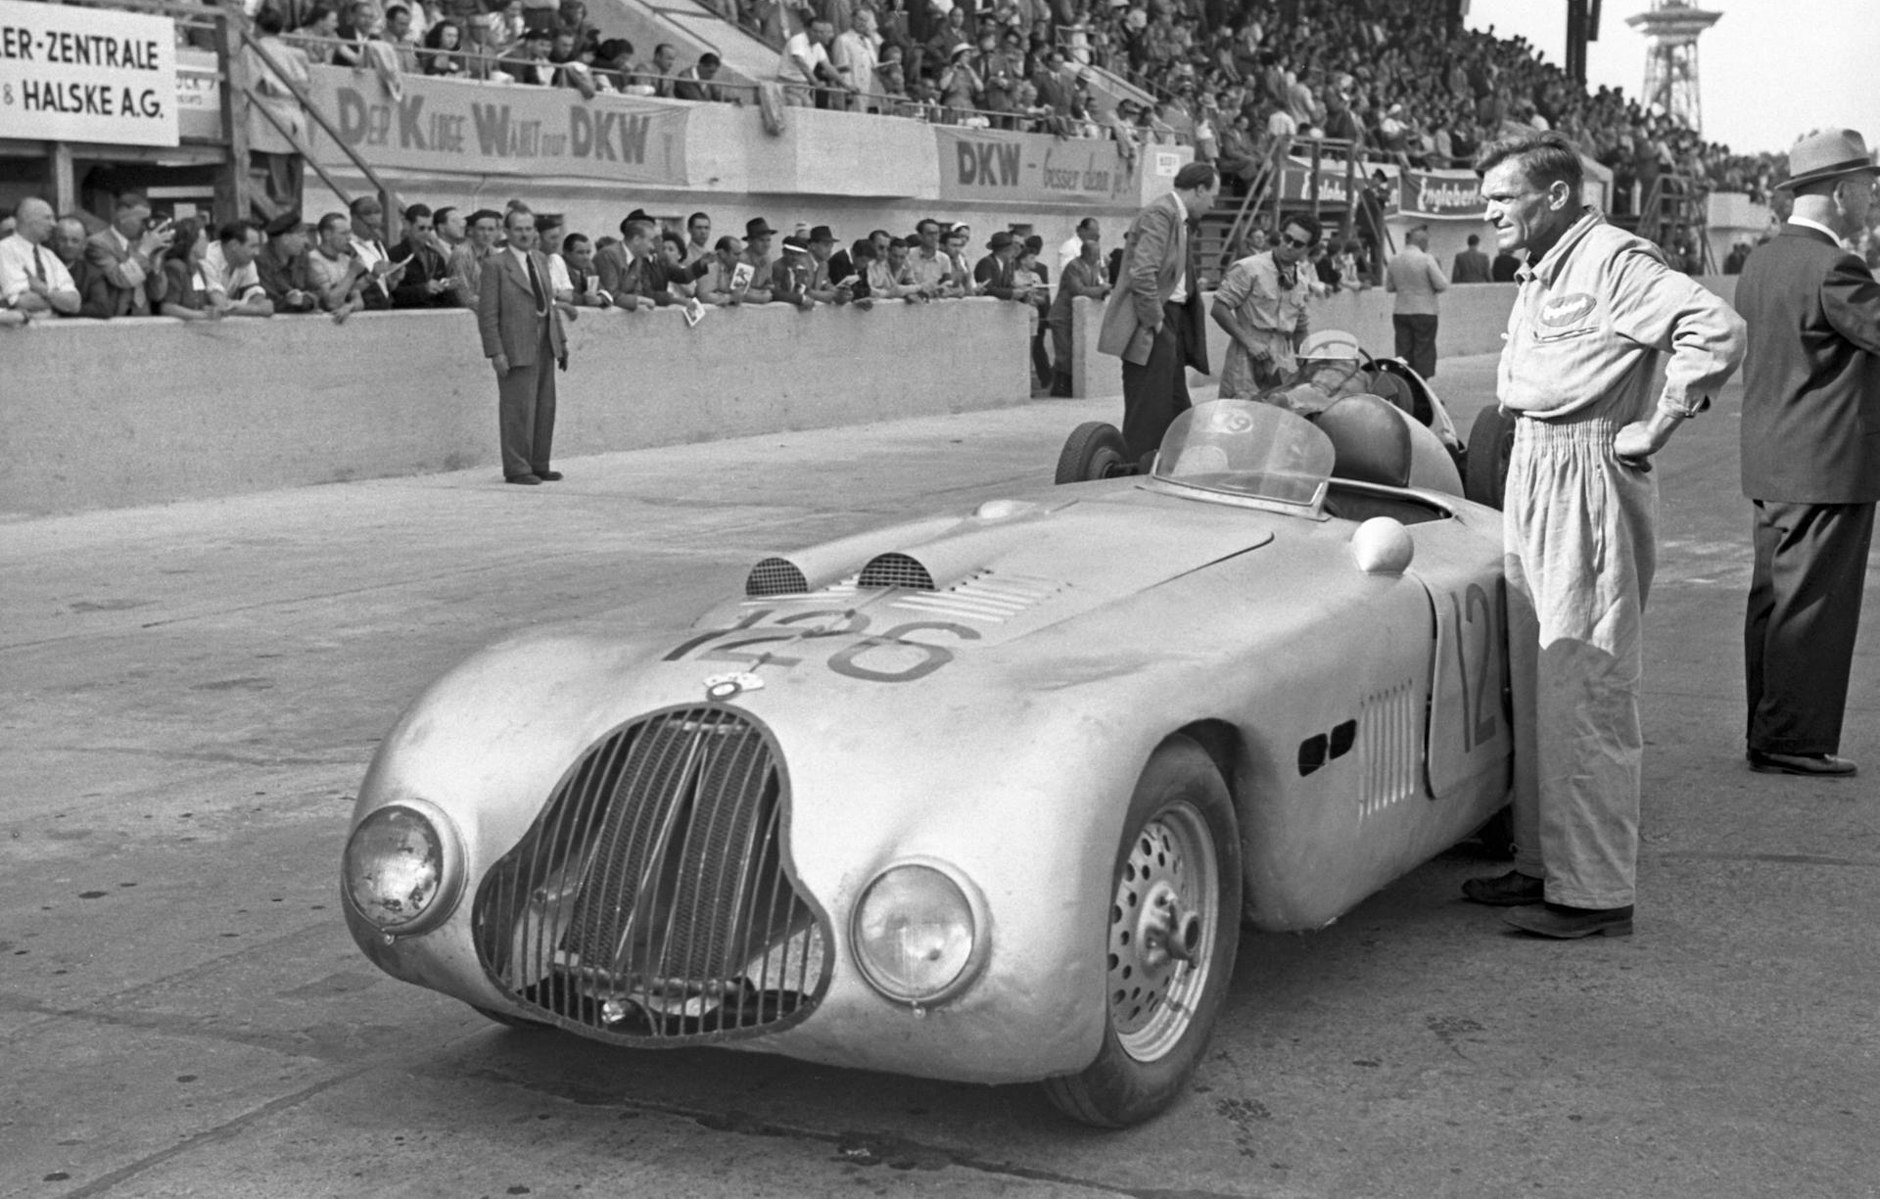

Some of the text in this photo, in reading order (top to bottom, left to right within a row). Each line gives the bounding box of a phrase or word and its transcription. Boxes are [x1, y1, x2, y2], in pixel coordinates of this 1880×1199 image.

[0, 26, 159, 70] ER-ZENTRALE
[2, 79, 164, 119] & HALSKE A.G.
[569, 104, 650, 165] DKW
[956, 140, 1022, 187] DKW
[661, 608, 983, 684] 126
[1450, 582, 1497, 753] 12
